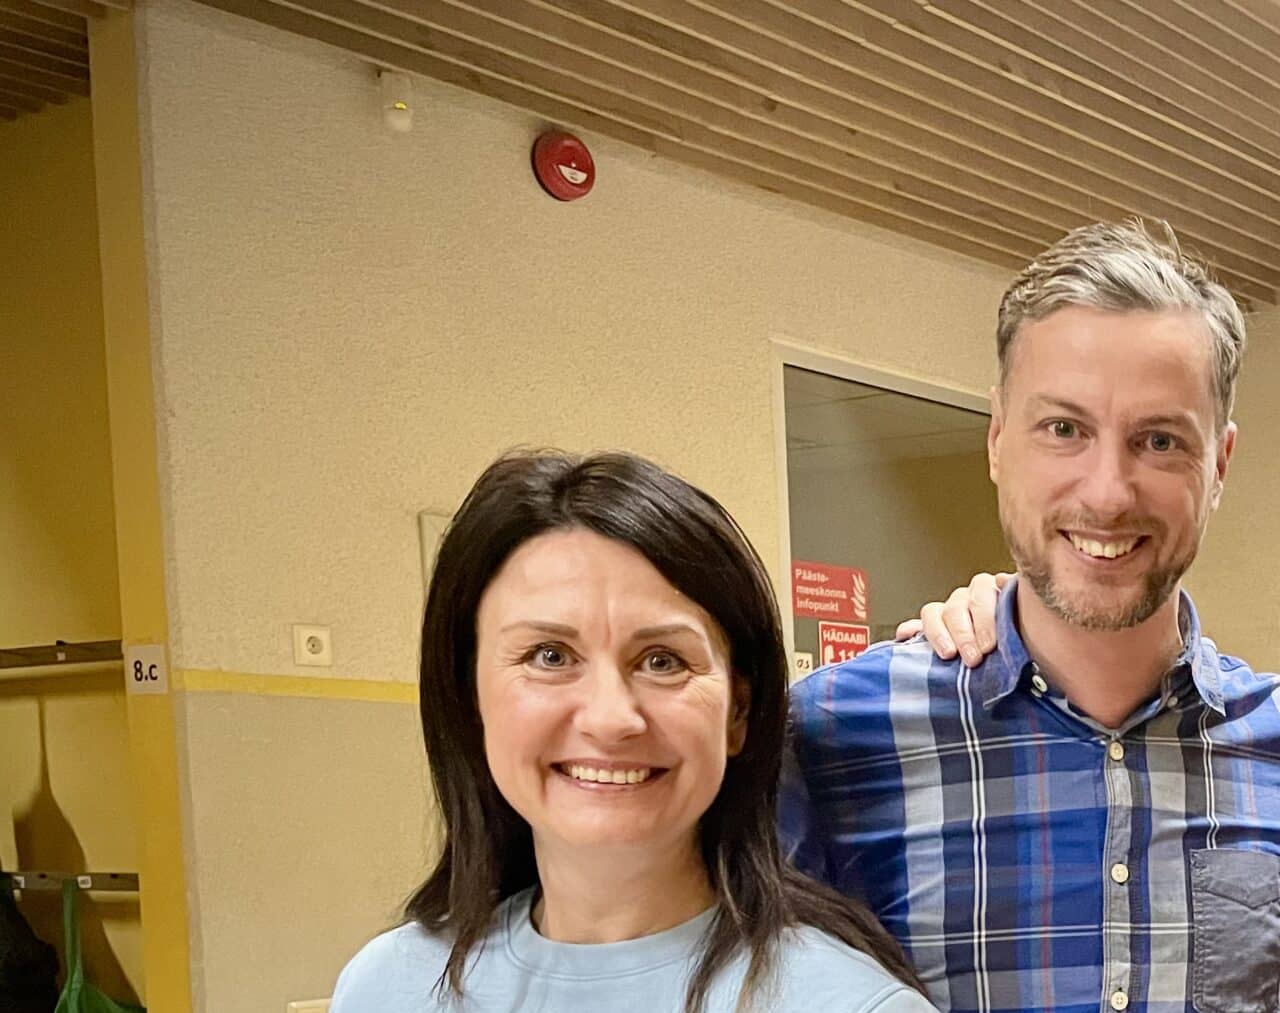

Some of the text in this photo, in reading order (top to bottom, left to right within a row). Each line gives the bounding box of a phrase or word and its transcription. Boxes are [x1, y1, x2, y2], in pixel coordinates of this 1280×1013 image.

[796, 585, 847, 600] meeskonna
[797, 597, 839, 613] infopunkt
[822, 629, 866, 645] HÄDAABI
[133, 659, 158, 682] 8.c
